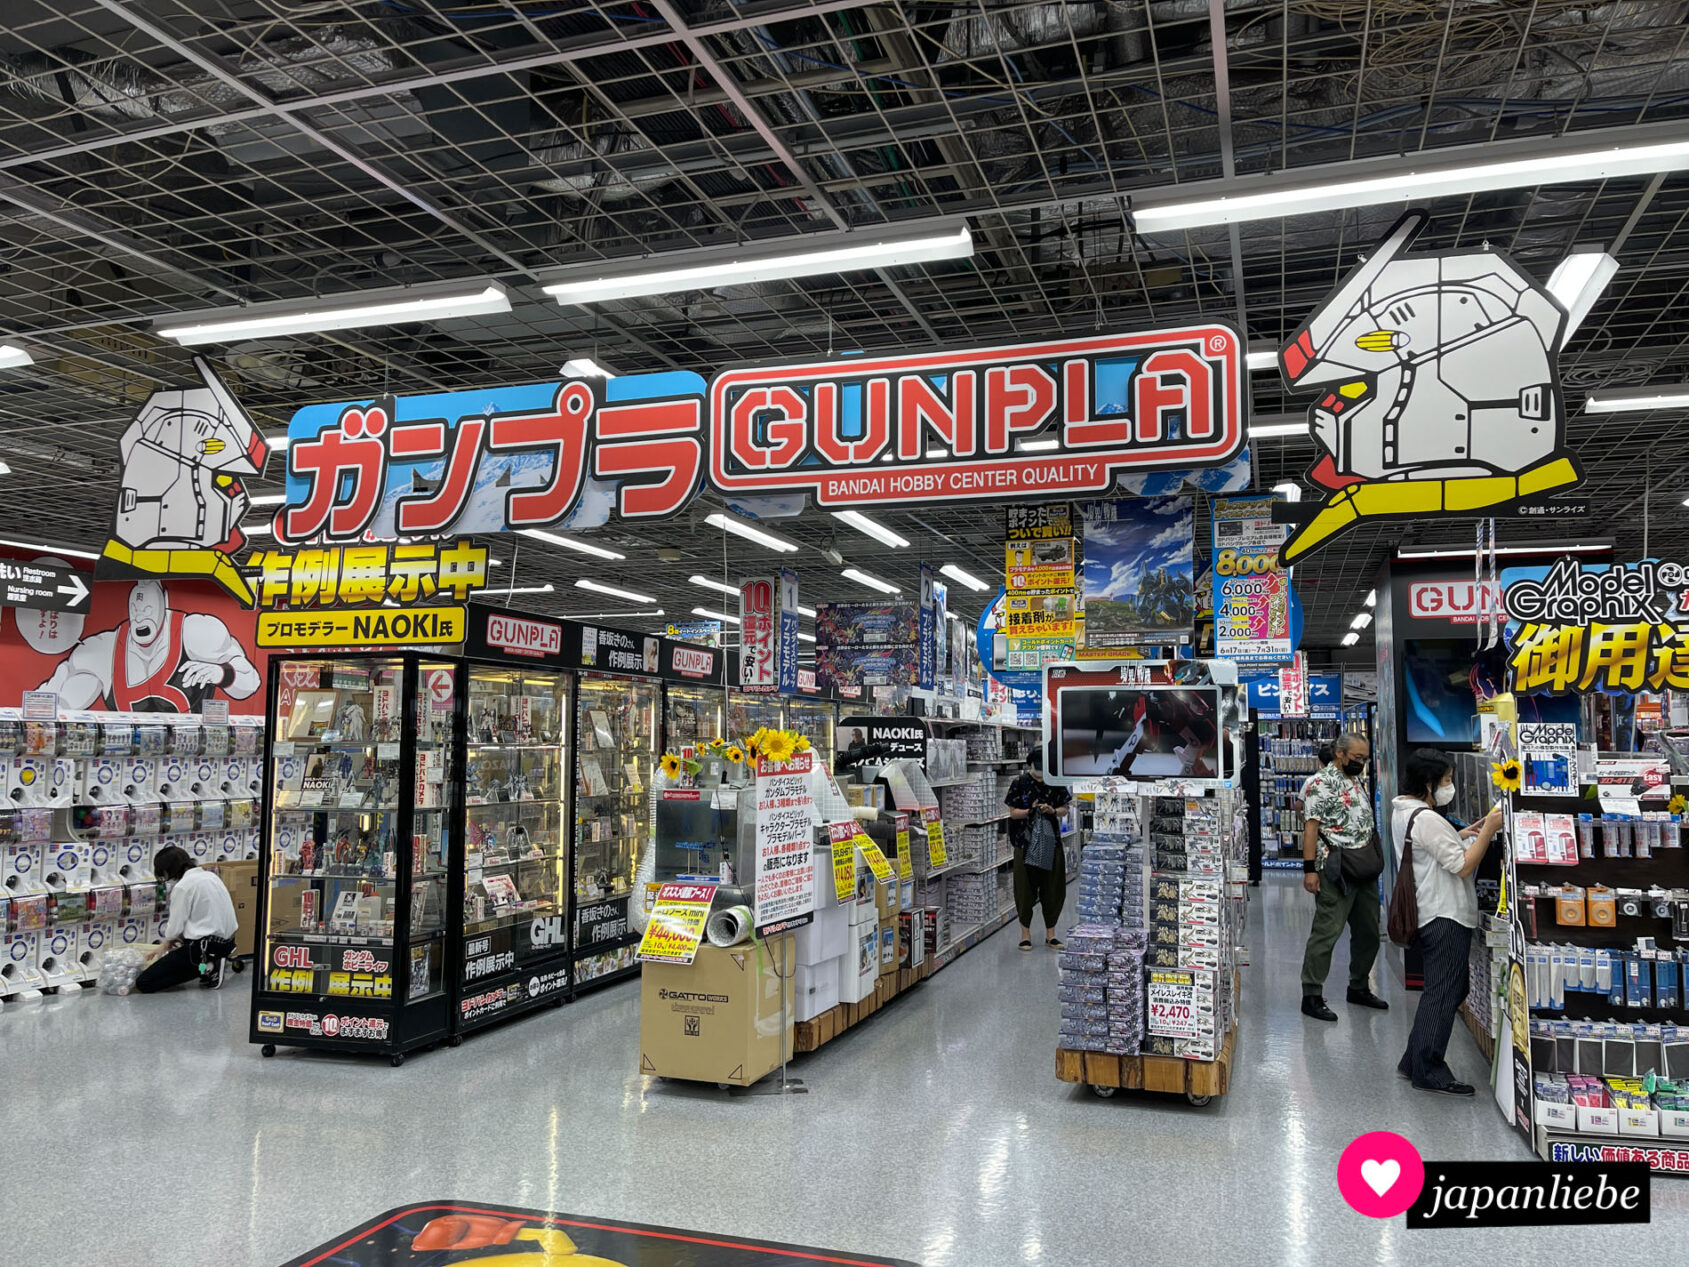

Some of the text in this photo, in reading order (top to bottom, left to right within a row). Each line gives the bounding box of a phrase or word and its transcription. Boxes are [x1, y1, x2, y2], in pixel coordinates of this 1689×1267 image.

[730, 349, 1214, 470] GUNPLA
[286, 380, 701, 539] ガンプラ
[828, 463, 1098, 496] BANDAI HOBBY CENTER QUALITY
[22, 566, 57, 578] Restroom
[246, 541, 487, 606] 作例展示中
[1541, 560, 1655, 597] Model
[7, 585, 34, 596] Nursing
[35, 588, 54, 598] room
[1504, 580, 1663, 626] Graphix
[1009, 611, 1054, 626] 接着剤が
[1219, 603, 1256, 617] 4,000
[267, 614, 453, 639] プロモデラー NAOKI氏
[490, 619, 560, 650] GUNPLA
[1218, 625, 1252, 637] 2,000
[608, 650, 643, 670] 作例展示
[757, 615, 772, 682] ポイント
[782, 618, 791, 686] プラモデル
[673, 650, 713, 672] GUNPLA
[872, 727, 924, 739] NAOKI氏
[1520, 731, 1576, 745] Graphix
[1643, 774, 1663, 782] Easy
[530, 916, 565, 946] GHL
[592, 918, 627, 943] 作例展示
[274, 945, 314, 969] GHL
[343, 949, 374, 962] ガンダム
[343, 961, 388, 972] ホビーライフ
[465, 950, 515, 981] 作例展示中
[270, 968, 314, 993] 作例
[669, 991, 706, 1001] GATTO
[1151, 1004, 1190, 1019] ¥2,470
